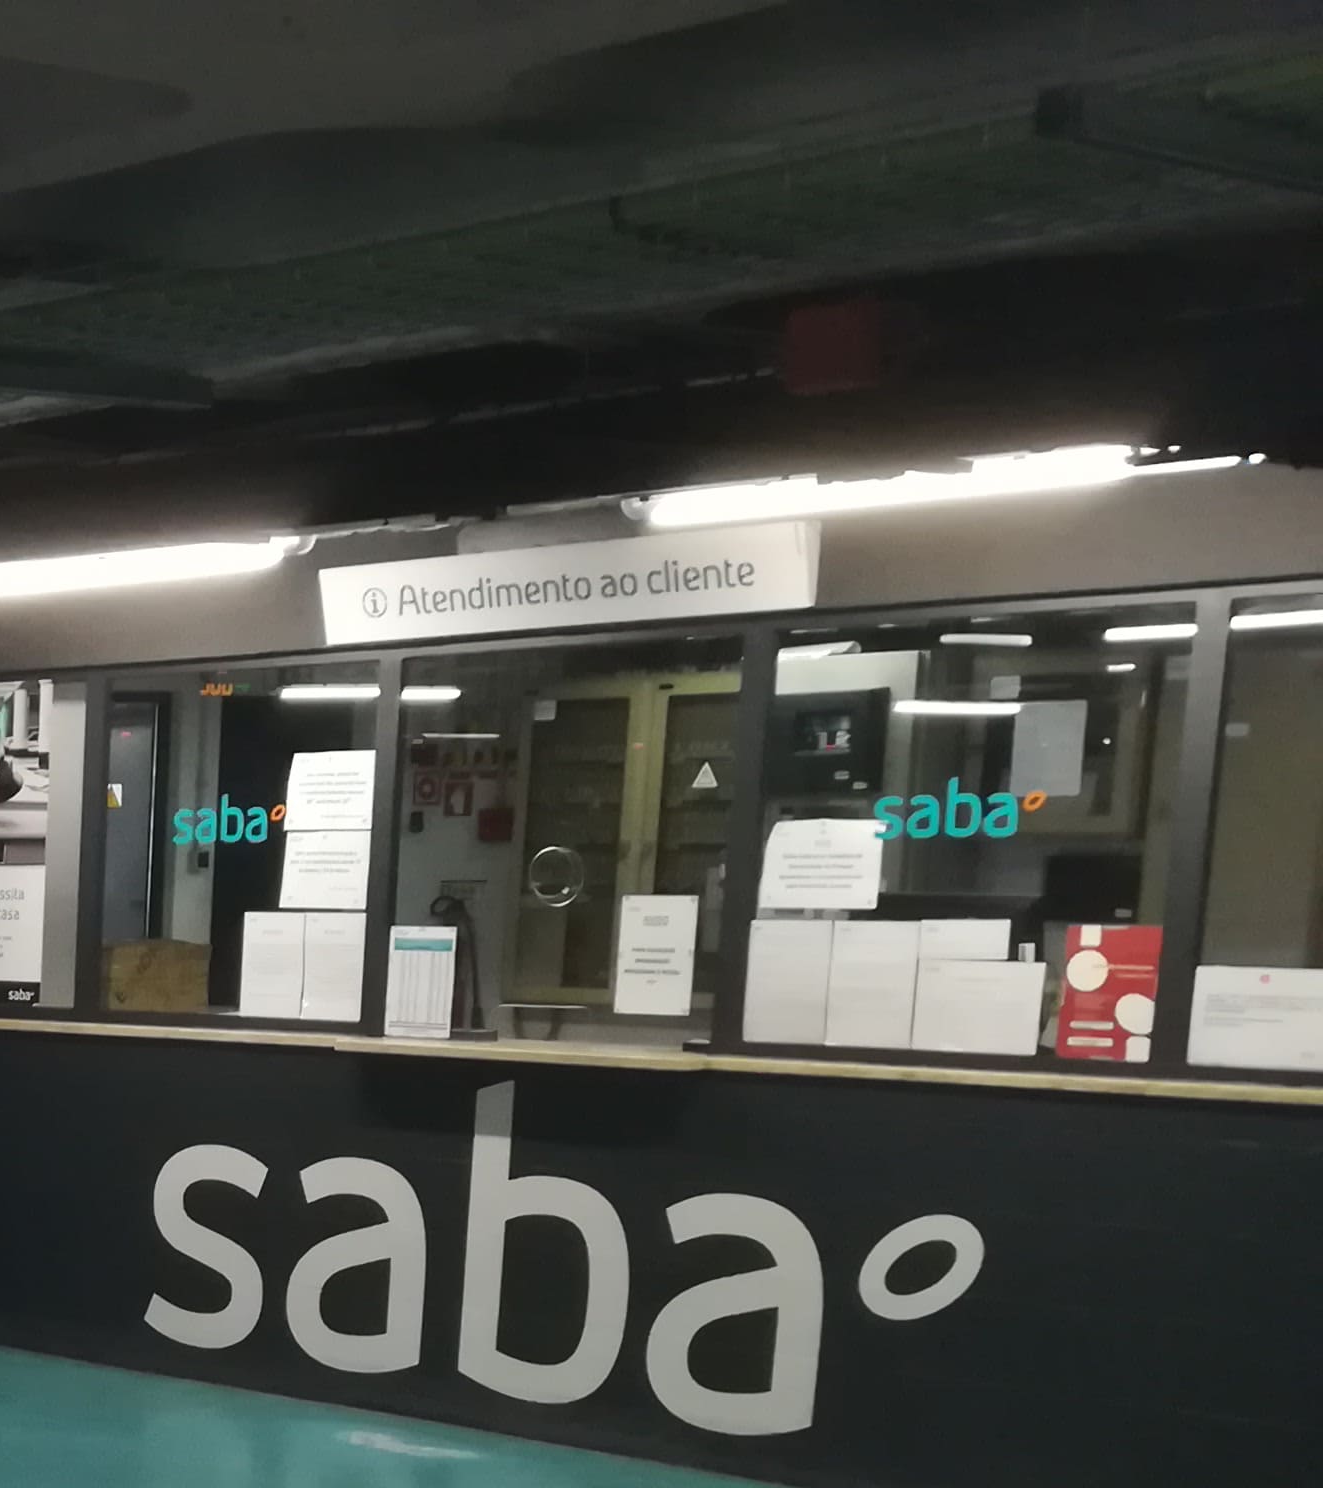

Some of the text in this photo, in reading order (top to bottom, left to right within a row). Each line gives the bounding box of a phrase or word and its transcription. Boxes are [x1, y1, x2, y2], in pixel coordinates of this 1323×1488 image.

[398, 560, 756, 616] Atendimento ao cliente
[172, 793, 269, 845] saba
[872, 776, 1020, 840] saba
[143, 1080, 825, 1436] saba
